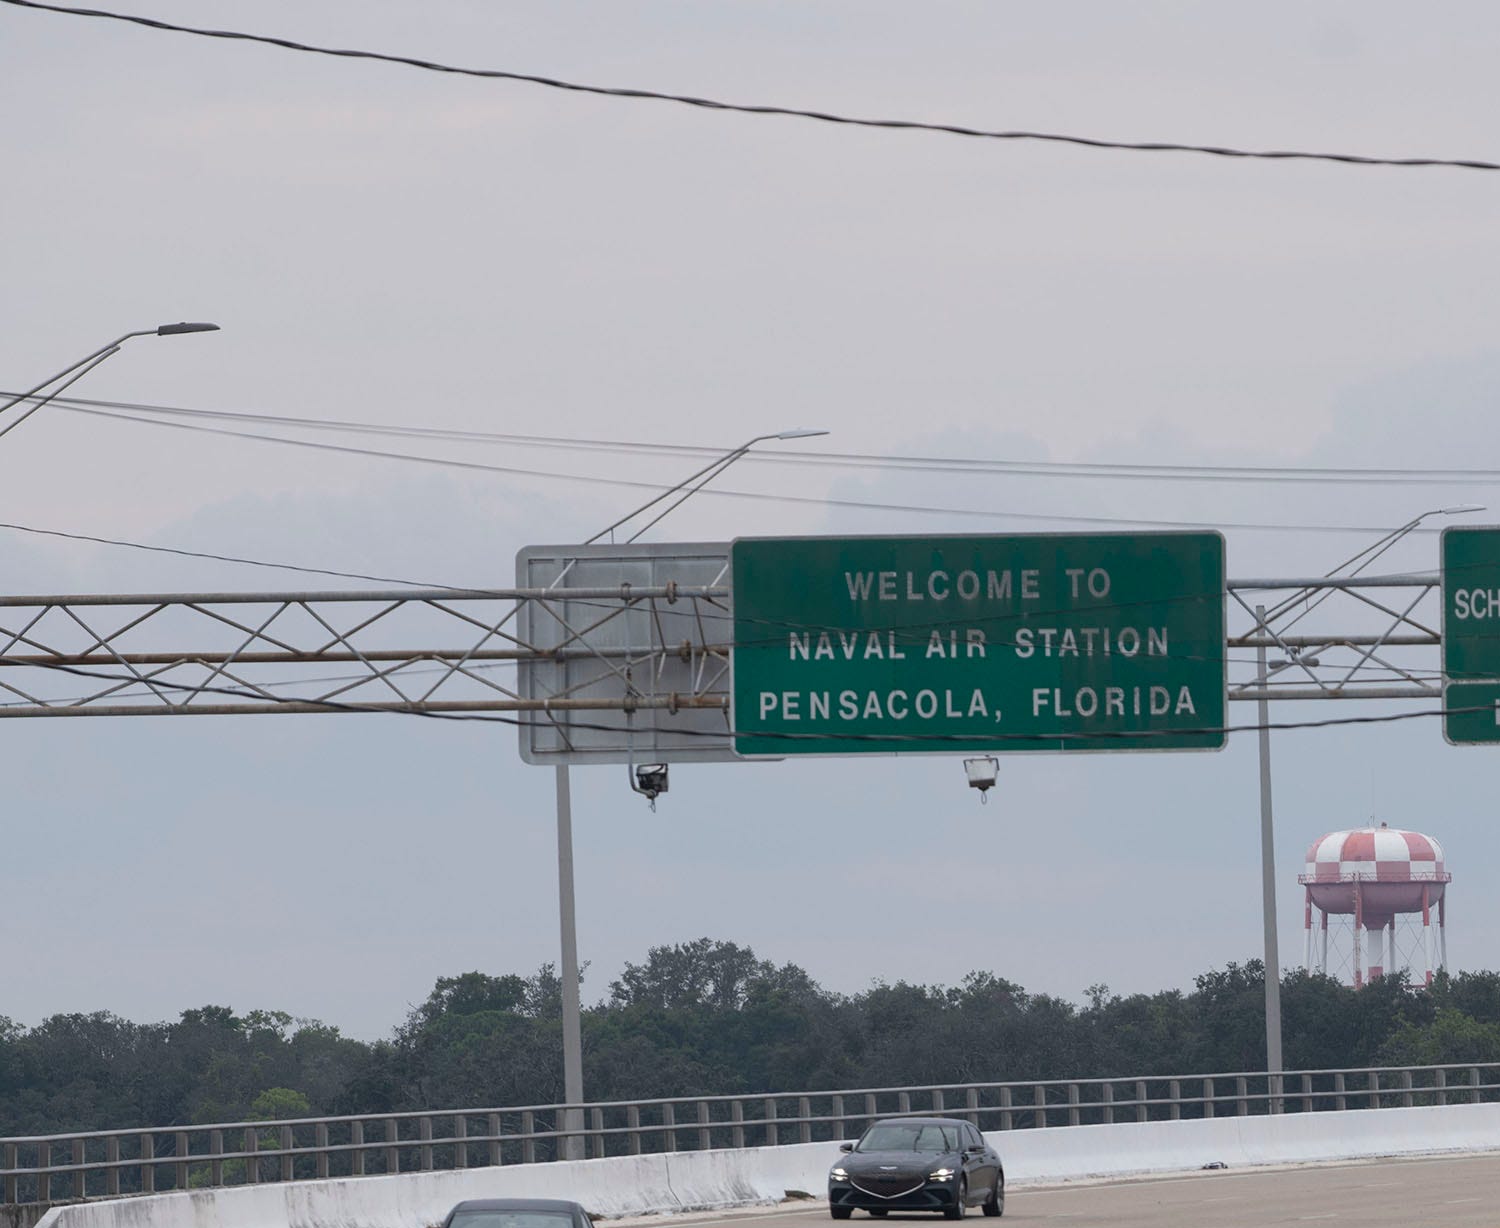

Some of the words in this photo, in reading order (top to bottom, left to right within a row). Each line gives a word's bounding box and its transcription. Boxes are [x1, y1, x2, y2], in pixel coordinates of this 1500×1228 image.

[845, 569, 1040, 601] WELCOME
[1065, 568, 1111, 598] TO
[789, 631, 905, 660] NAVAL
[925, 629, 986, 659] AIR
[1015, 627, 1169, 658] STATION
[759, 688, 1002, 723] PENSACOLA,
[1033, 685, 1196, 717] FLORIDA
